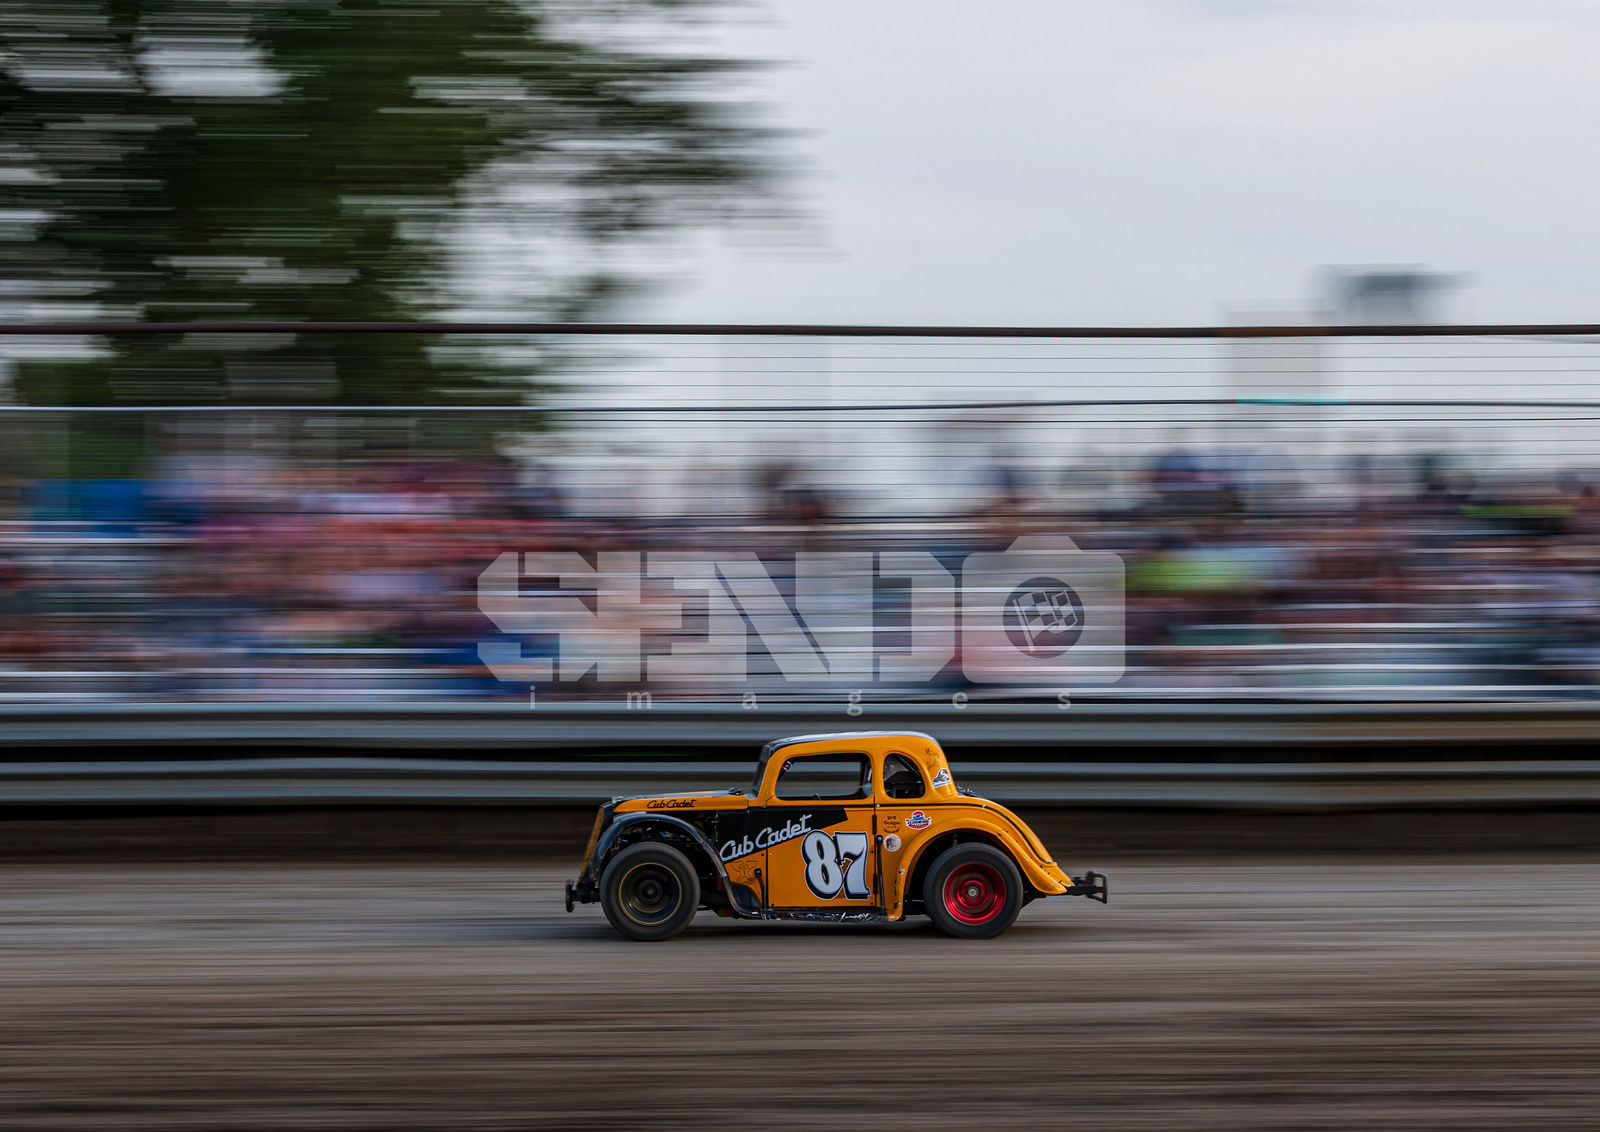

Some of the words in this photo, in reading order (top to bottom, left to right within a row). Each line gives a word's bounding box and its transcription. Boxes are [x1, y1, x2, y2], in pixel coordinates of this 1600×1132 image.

[646, 800, 666, 809] Cub
[666, 799, 697, 808] Cadet
[719, 834, 754, 862] Cub
[755, 813, 812, 849] Cadet
[801, 829, 871, 900] 87
